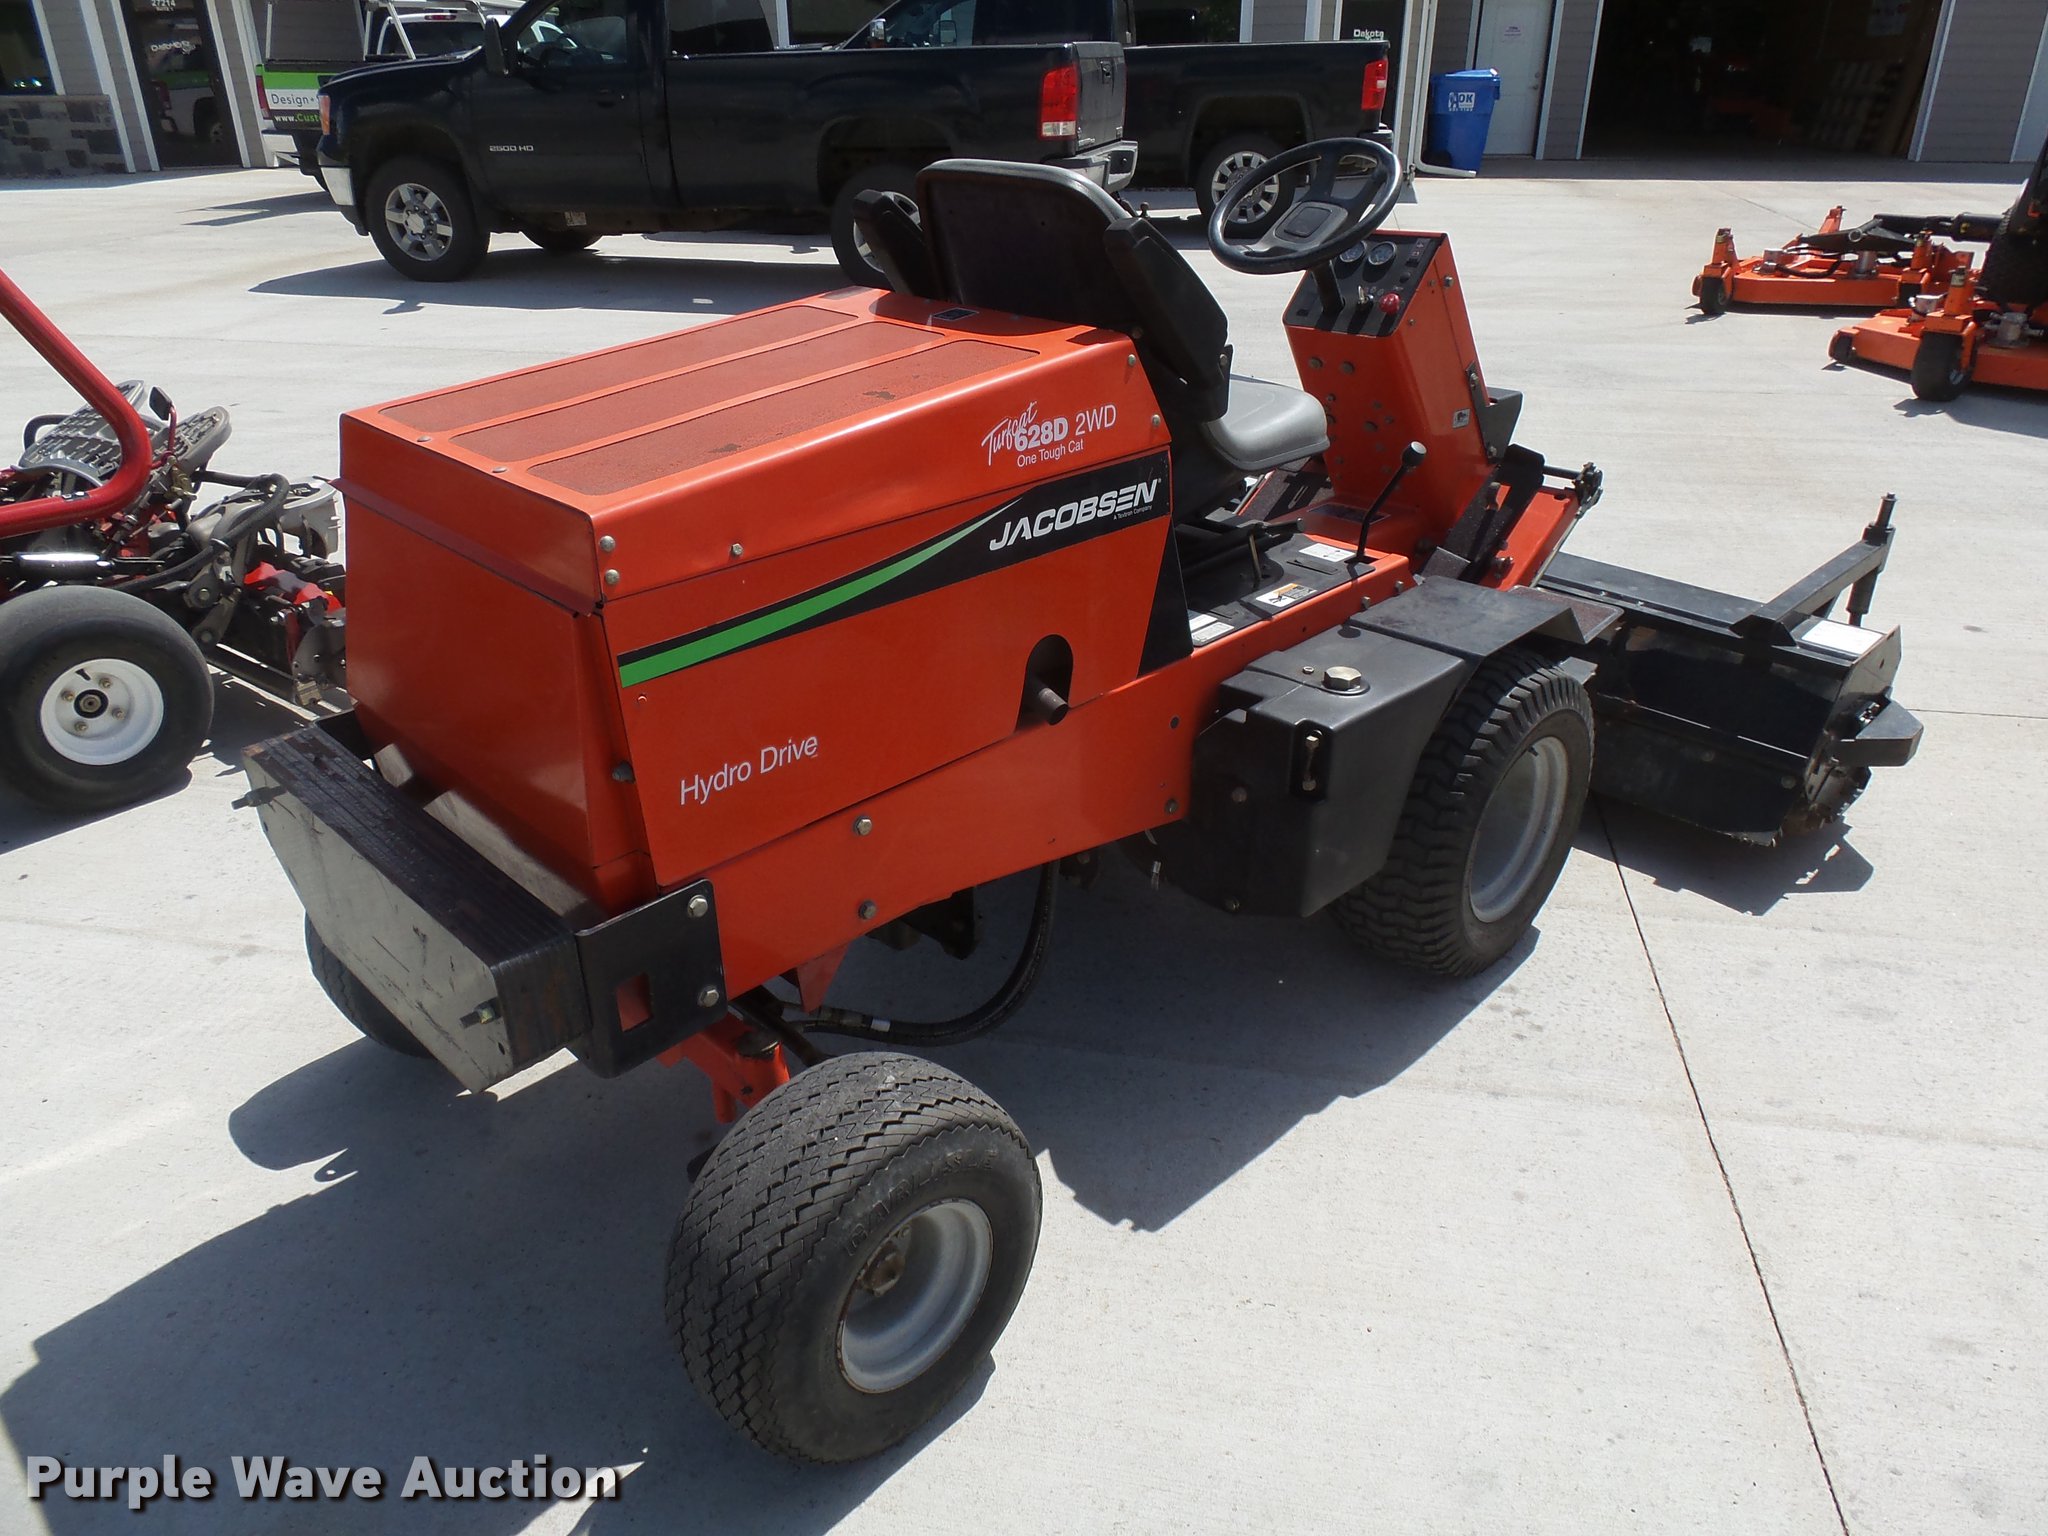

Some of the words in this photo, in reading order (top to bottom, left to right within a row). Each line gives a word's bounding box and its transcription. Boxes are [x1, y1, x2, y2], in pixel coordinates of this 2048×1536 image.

[271, 93, 309, 107] Design
[981, 401, 1038, 467] Turfcat
[1014, 417, 1069, 452] 628D
[1075, 404, 1117, 436] 2WD
[1017, 454, 1038, 468] One
[1038, 443, 1067, 461] Tough
[1068, 438, 1084, 454] Cat
[988, 478, 1159, 551] JACOBSEN
[680, 763, 752, 806] Hydro
[760, 736, 818, 774] Drive
